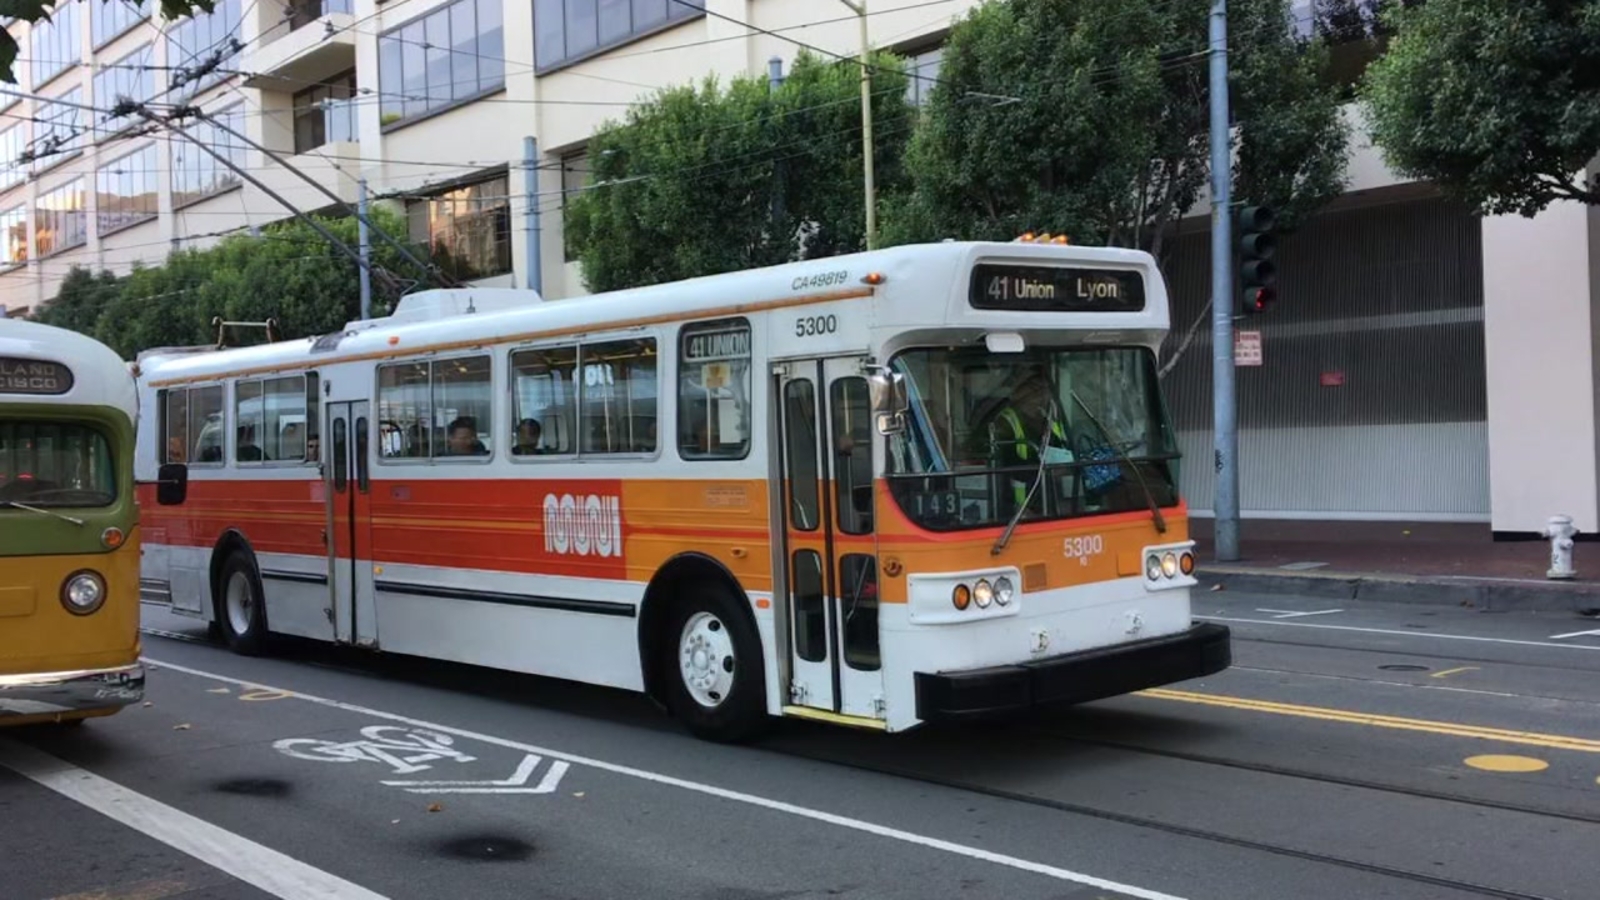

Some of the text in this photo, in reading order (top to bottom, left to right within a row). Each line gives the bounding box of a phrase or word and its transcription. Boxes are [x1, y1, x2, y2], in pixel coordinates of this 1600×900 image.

[791, 270, 848, 290] CA49819
[988, 276, 1117, 301] 41 Union Lyon
[795, 314, 837, 337] 5300
[689, 332, 749, 357] 41 UNION
[1063, 535, 1102, 558] 5300
